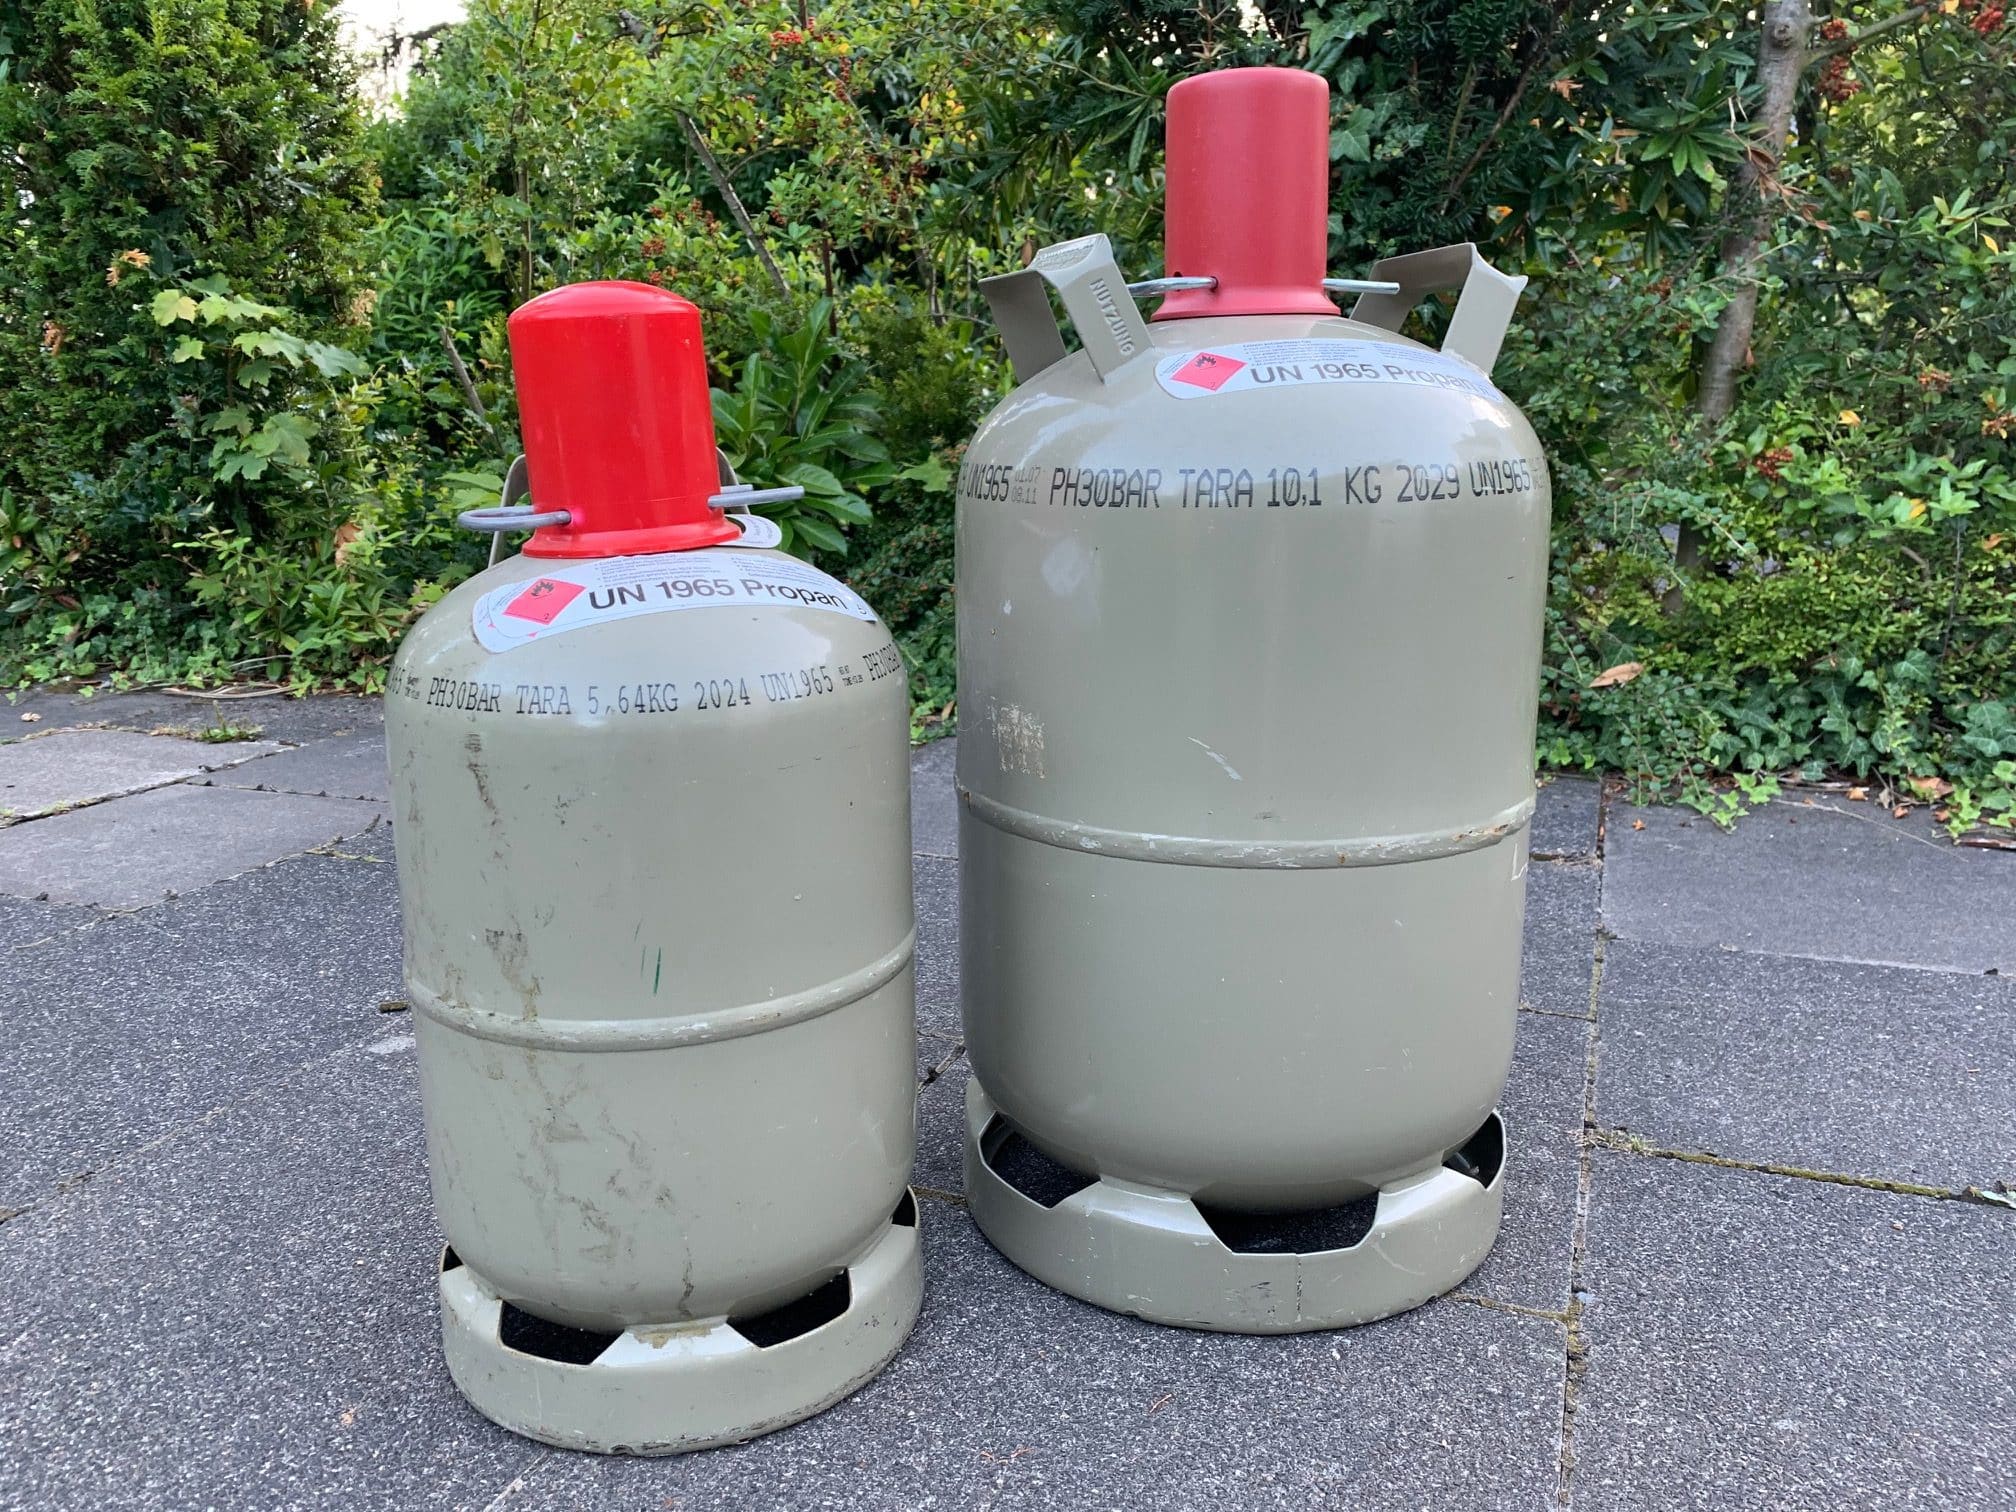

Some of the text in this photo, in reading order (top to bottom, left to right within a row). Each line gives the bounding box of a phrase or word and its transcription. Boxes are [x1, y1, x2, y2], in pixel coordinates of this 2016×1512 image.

[1090, 278, 1135, 355] NUTZUNG
[1250, 363, 1480, 391] UN 1965 Propan
[966, 463, 1013, 501] UN1965
[1050, 467, 1162, 508] PH30BAR
[1179, 468, 1253, 509] TARA
[1267, 467, 1322, 507] 10,1
[1345, 465, 1382, 504] KG
[1396, 463, 1460, 503] 2029
[1469, 458, 1530, 497] UN1965
[589, 579, 848, 610] UN 1965 Propan
[427, 677, 501, 713] PH30BAR
[516, 684, 572, 715] TARA
[694, 677, 751, 710] 2024
[760, 665, 834, 702] UN1965
